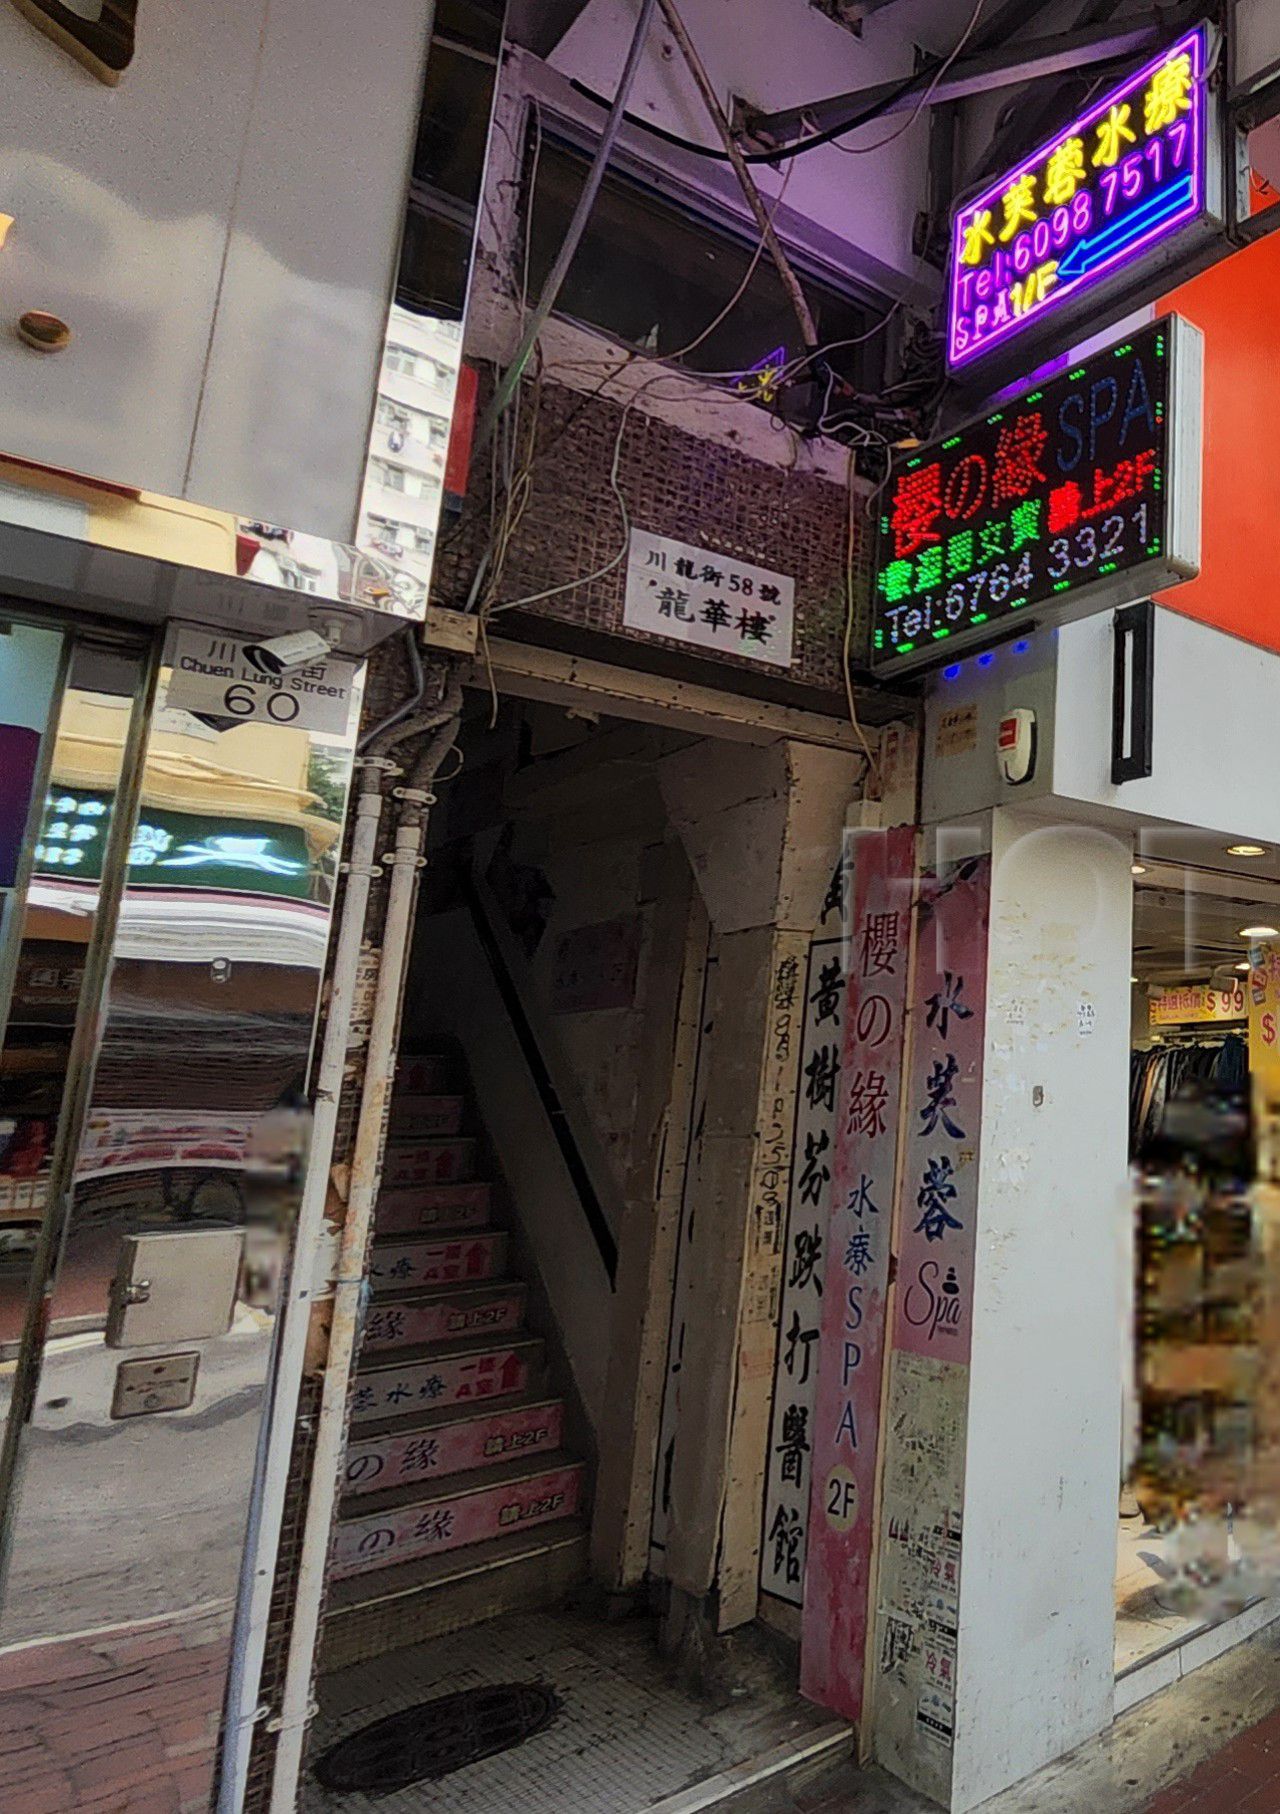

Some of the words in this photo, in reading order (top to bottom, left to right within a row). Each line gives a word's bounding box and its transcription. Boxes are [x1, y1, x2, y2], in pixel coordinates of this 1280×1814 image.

[1100, 121, 1188, 215] 7517
[1057, 358, 1154, 472] SPA
[645, 551, 781, 605] 川龍街58號
[1048, 503, 1147, 578] 3321
[181, 656, 234, 677] Chuen
[242, 668, 283, 690] Lung
[290, 678, 346, 699] Street
[223, 684, 300, 722] 60
[847, 911, 900, 1138] 櫻の緣
[913, 972, 974, 1242] 水芙蓉
[904, 1261, 962, 1340] Spa
[827, 1480, 855, 1519] 2F
